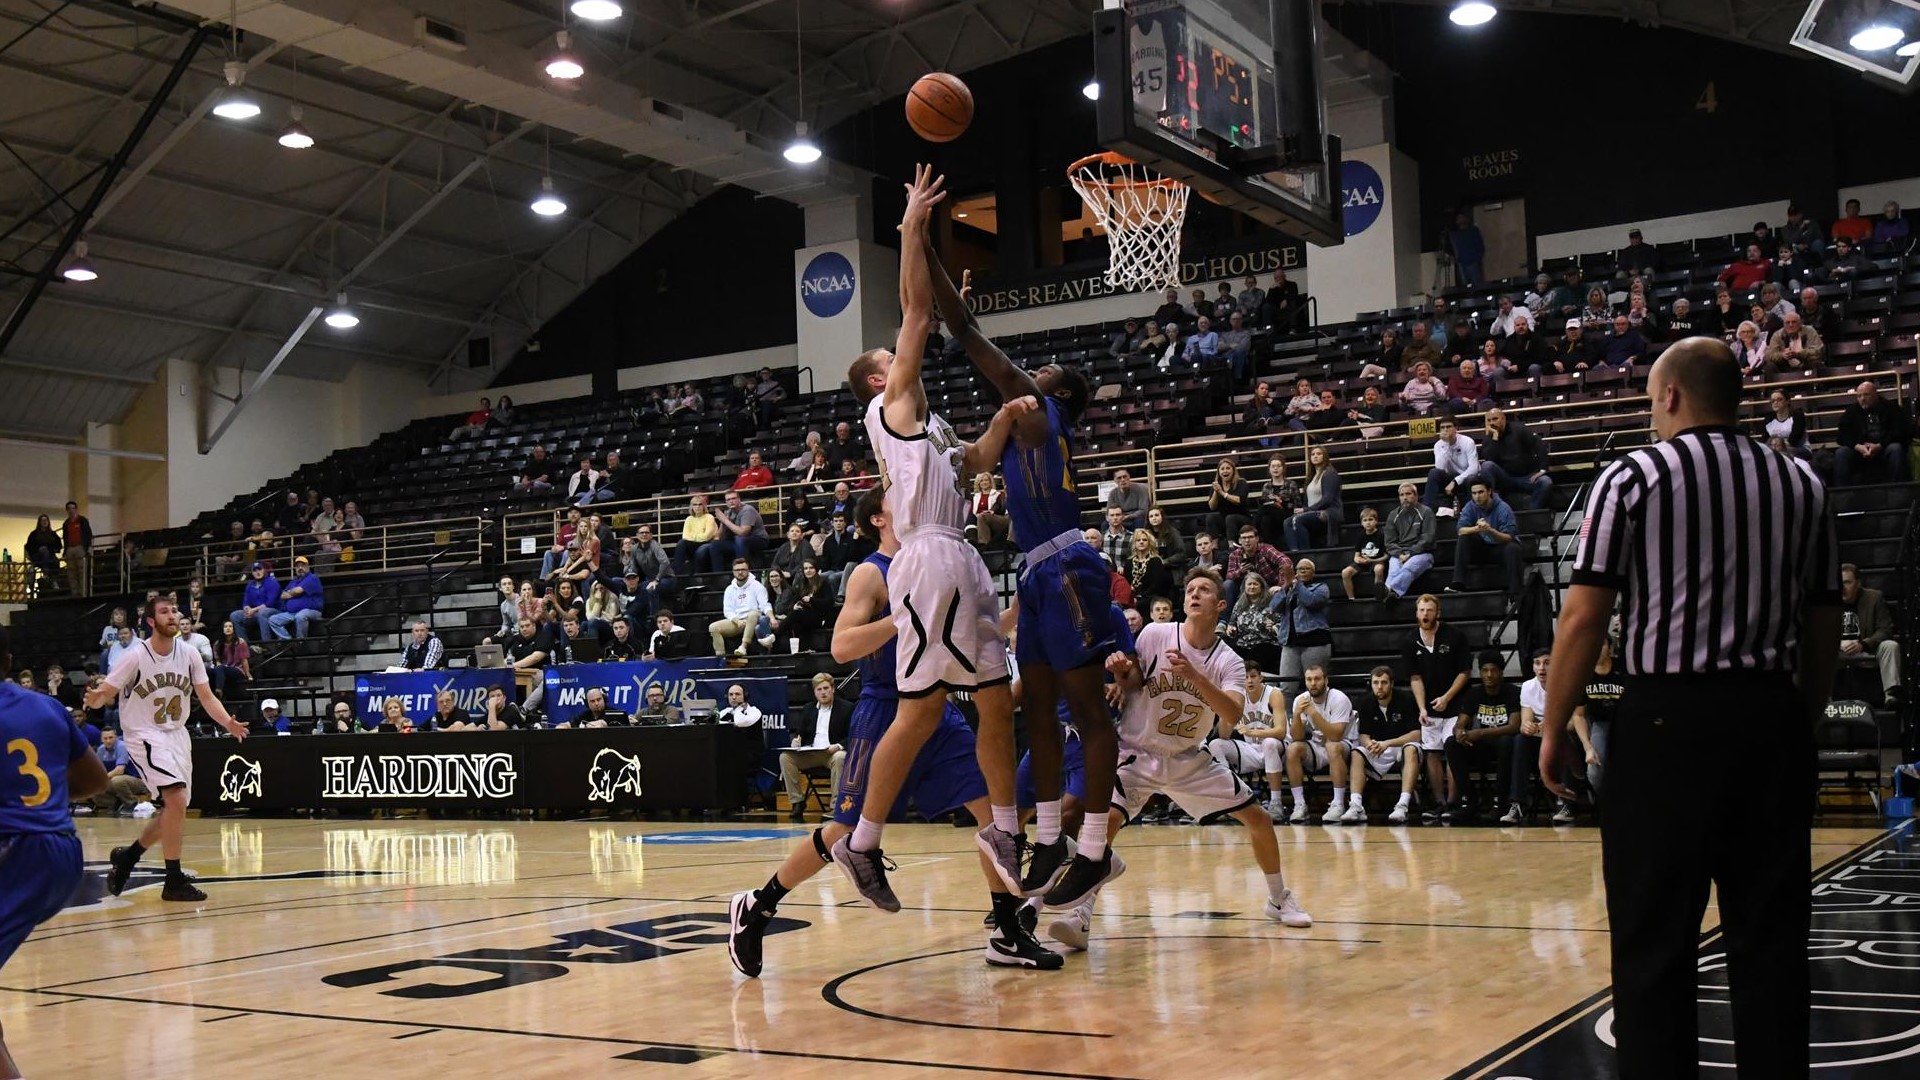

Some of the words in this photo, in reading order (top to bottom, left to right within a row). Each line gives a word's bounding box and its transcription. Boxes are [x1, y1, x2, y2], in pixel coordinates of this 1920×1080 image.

[1132, 68, 1163, 93] 45
[1696, 81, 1718, 113] 4
[1462, 149, 1519, 169] REAVES
[1469, 162, 1512, 181] ROOM
[1208, 246, 1299, 278] HOUSE
[656, 269, 669, 293] 2
[803, 274, 852, 295] NCAA
[1410, 422, 1435, 435] HOME
[760, 500, 777, 512] HOME
[612, 515, 628, 526] HOME
[416, 693, 432, 712] IT
[613, 685, 632, 705] IT
[153, 695, 183, 724] 24
[1158, 698, 1203, 738] 22
[1838, 704, 1866, 716] Unity
[7, 738, 52, 807] 3
[322, 752, 517, 799] HARDING
